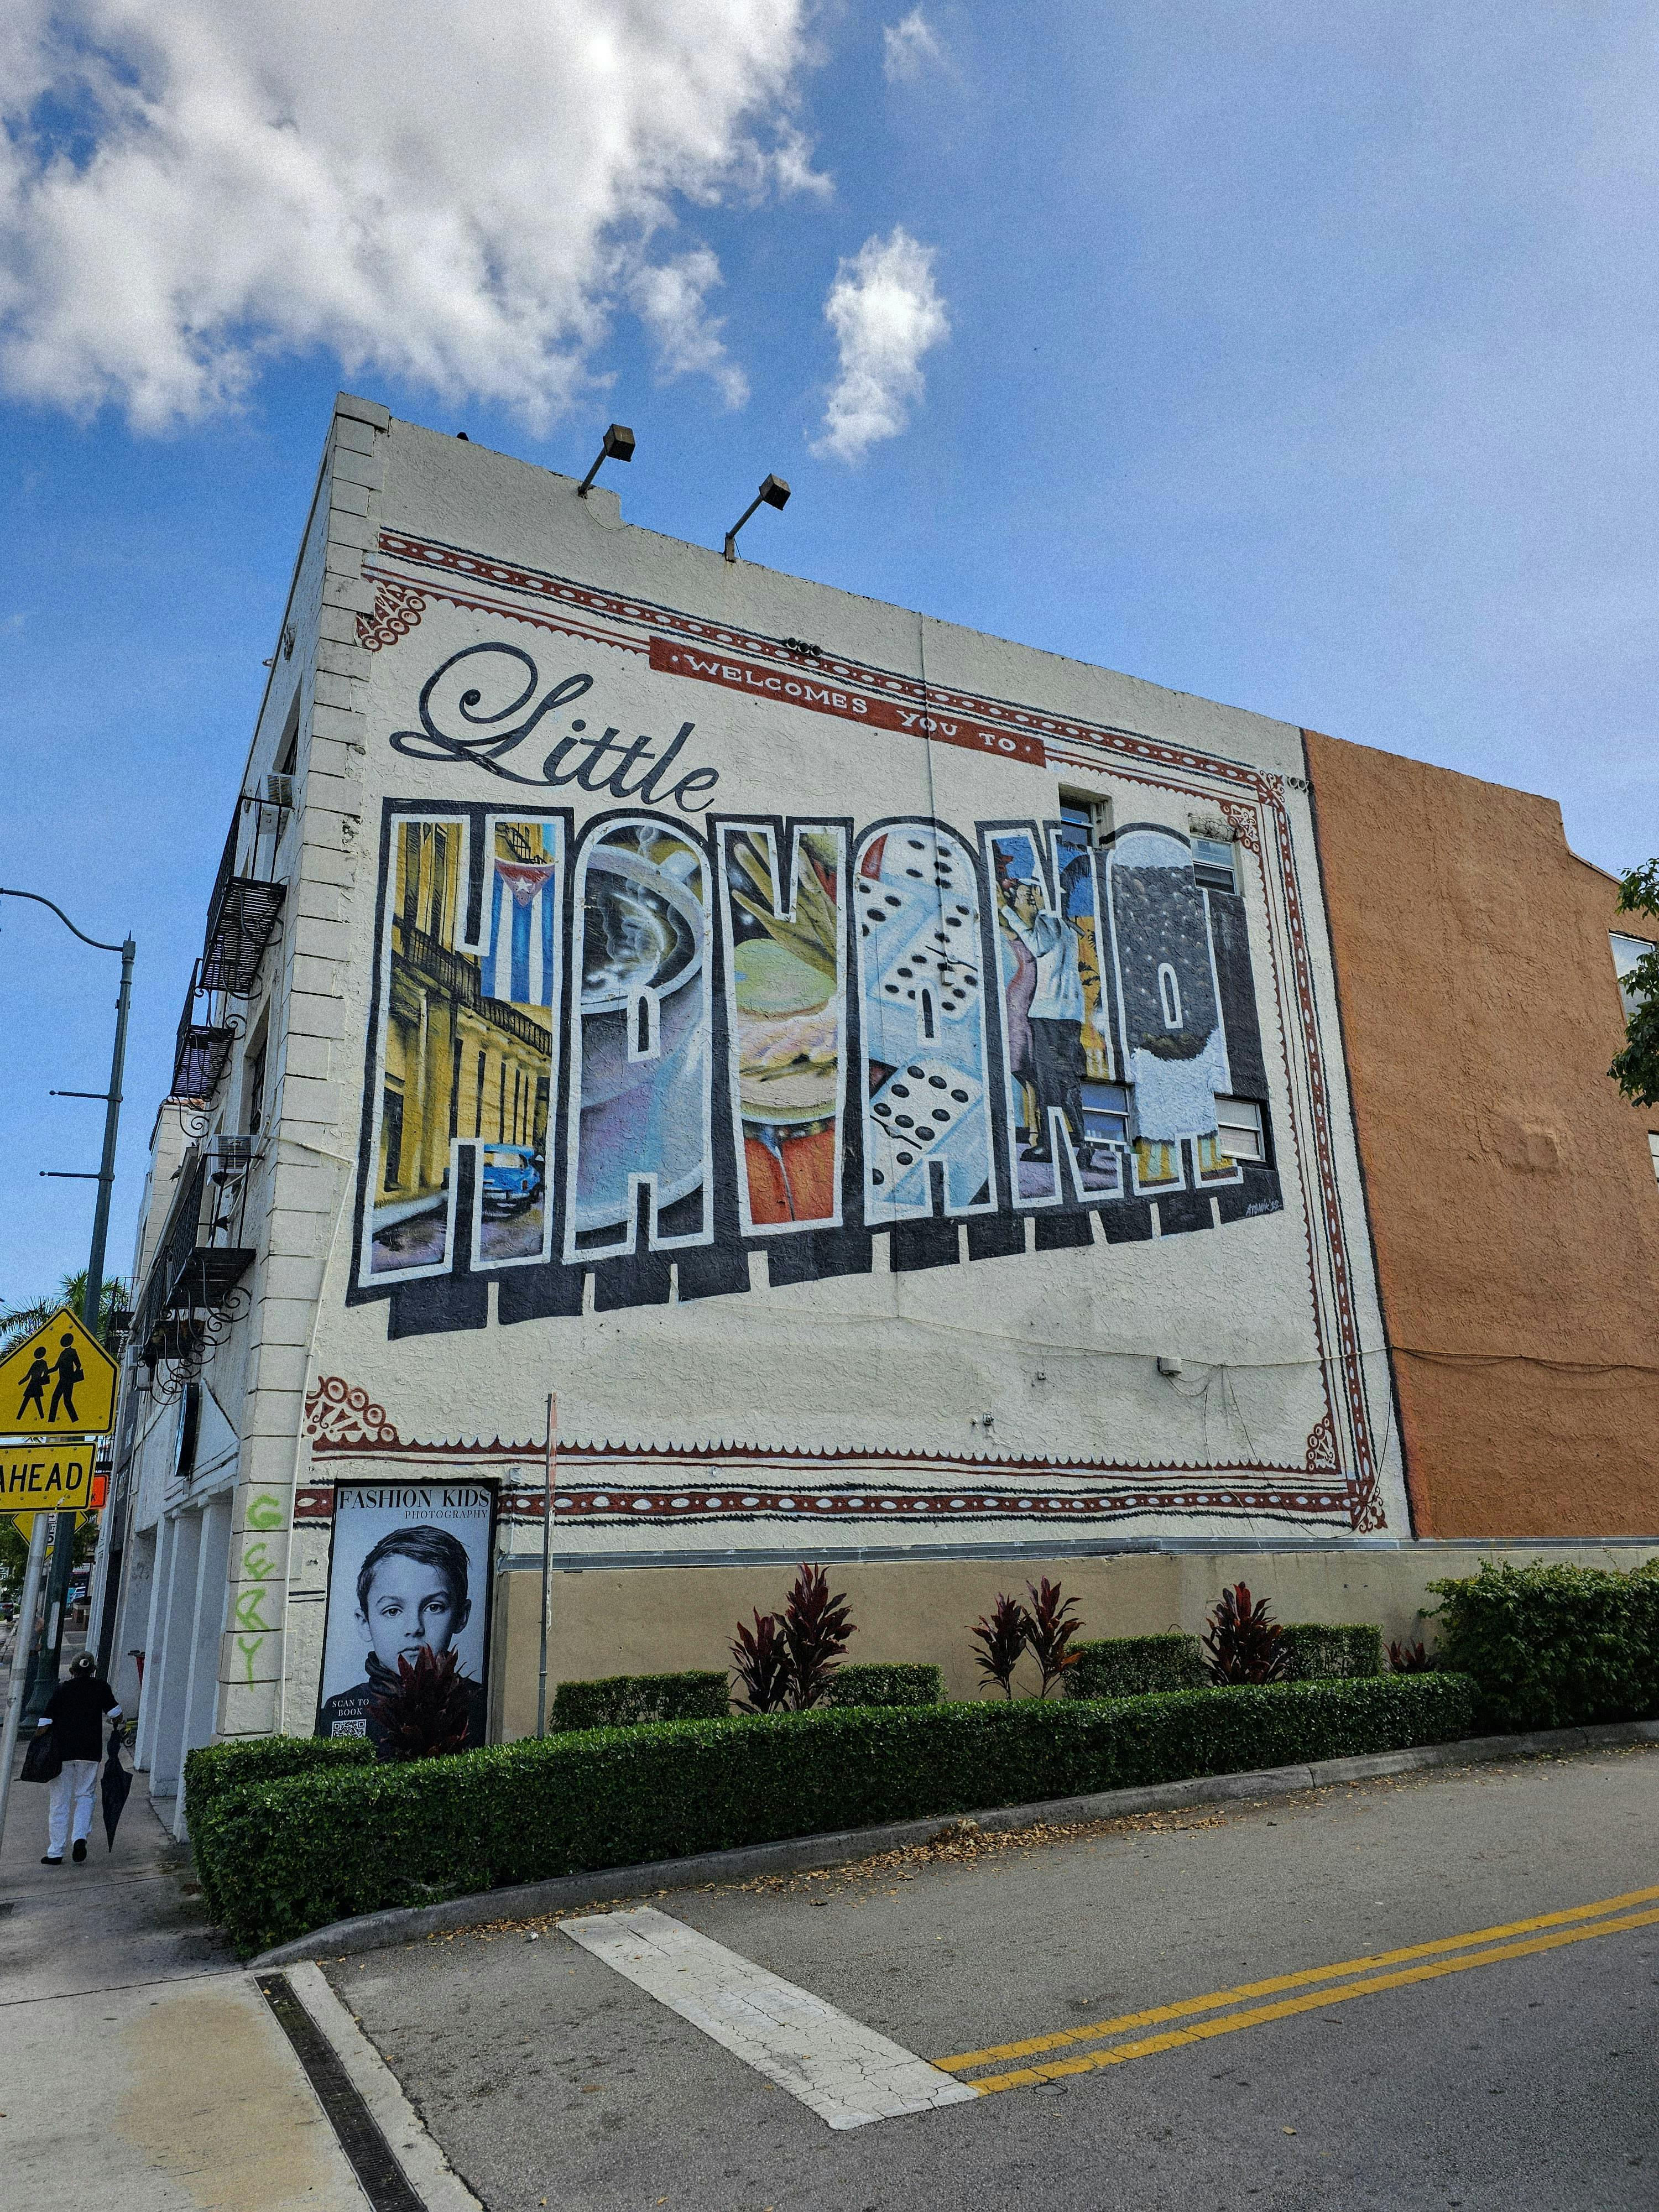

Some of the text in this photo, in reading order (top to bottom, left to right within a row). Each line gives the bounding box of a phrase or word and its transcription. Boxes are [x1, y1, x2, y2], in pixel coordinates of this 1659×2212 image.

[683, 654, 1016, 752] WELCOMES YOU TO
[389, 641, 719, 813] Little
[348, 796, 1283, 1327] HAVANA
[339, 1489, 490, 1509] FASHION KIDS
[405, 1510, 488, 1520] PHOTOGRAPHY
[332, 1699, 354, 1708] SCAN
[338, 1708, 362, 1717] BOOK
